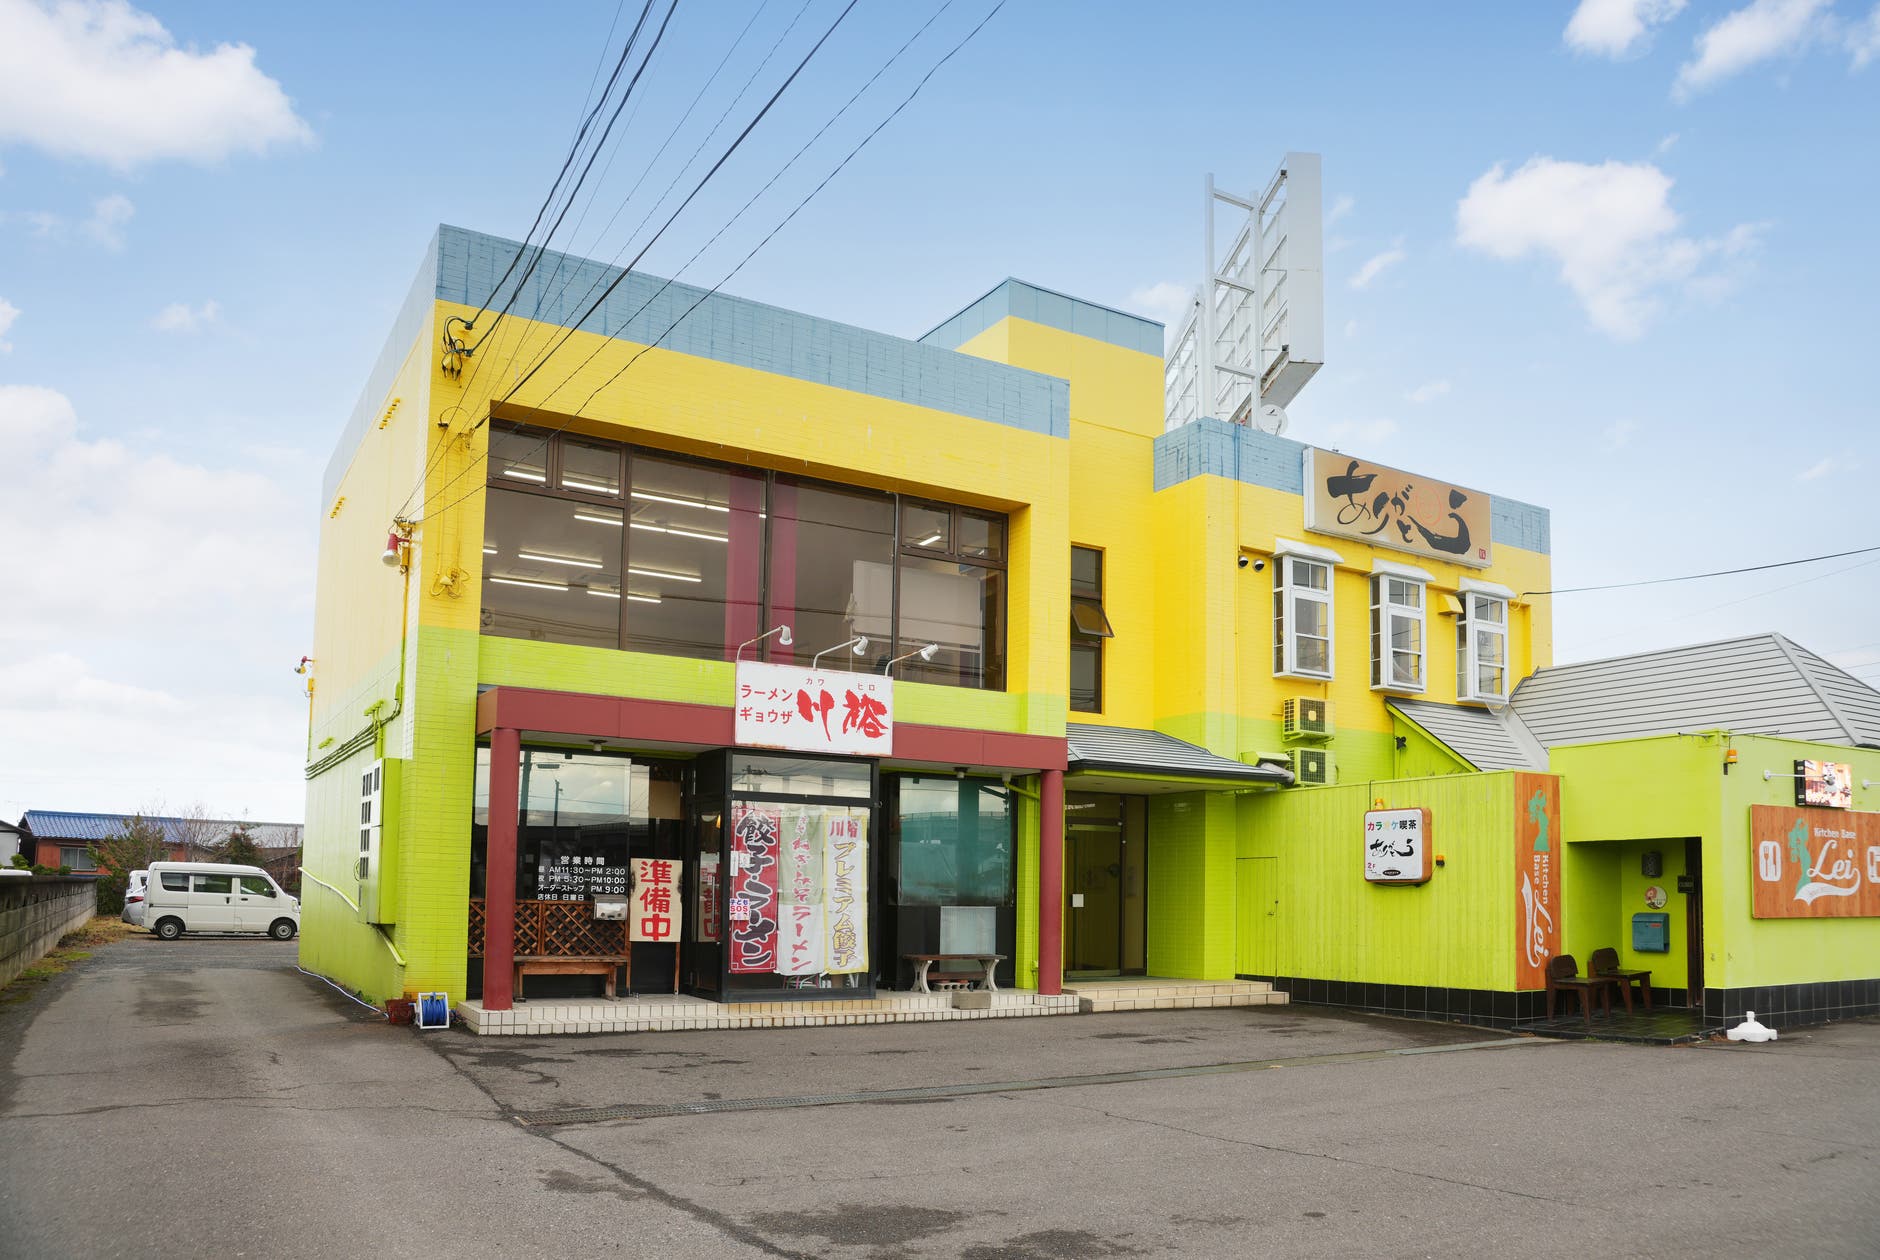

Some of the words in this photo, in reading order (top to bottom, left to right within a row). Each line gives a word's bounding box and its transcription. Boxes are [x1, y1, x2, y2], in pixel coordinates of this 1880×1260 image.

[741, 684, 793, 702] ラーメン
[806, 678, 825, 686] カワ
[857, 682, 875, 691] ヒロ
[740, 706, 793, 725] ギョウザ
[796, 689, 889, 742] 川裕
[560, 855, 605, 866] 営業時間
[1806, 840, 1854, 880] Lei
[605, 867, 626, 876] 2:00
[537, 884, 585, 892] オーダーストップ
[605, 885, 625, 894] 9:00
[640, 860, 673, 941] 準備中
[730, 905, 749, 913] SOS
[1533, 890, 1553, 958] Lei
